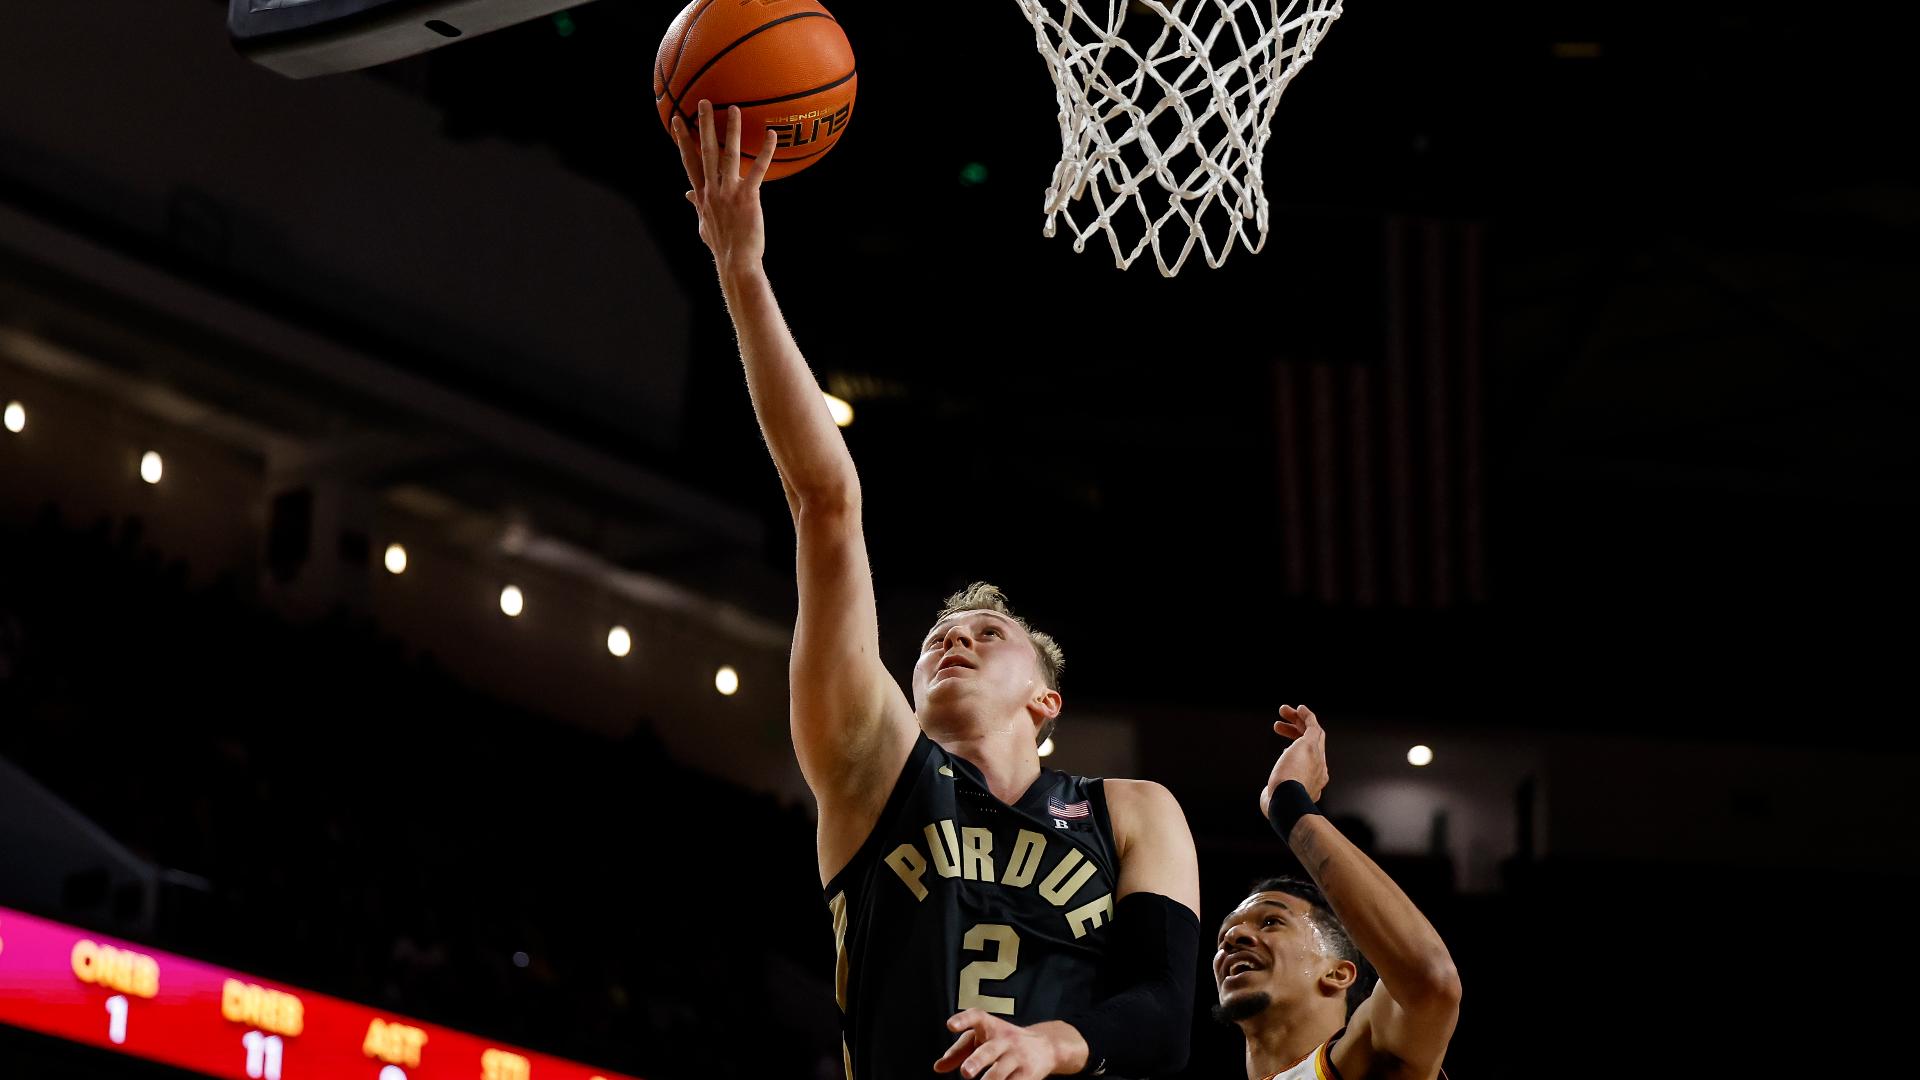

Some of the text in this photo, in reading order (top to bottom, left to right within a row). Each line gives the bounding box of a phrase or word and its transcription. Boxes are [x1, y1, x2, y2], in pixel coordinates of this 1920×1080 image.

[766, 101, 849, 149] ELITE
[884, 819, 1114, 939] PURDUE
[71, 939, 160, 998] OREB
[958, 923, 1021, 1015] 2
[105, 995, 128, 1044] 1
[222, 978, 304, 1037] DREB
[242, 1031, 284, 1080] 11
[363, 1017, 429, 1069] AST
